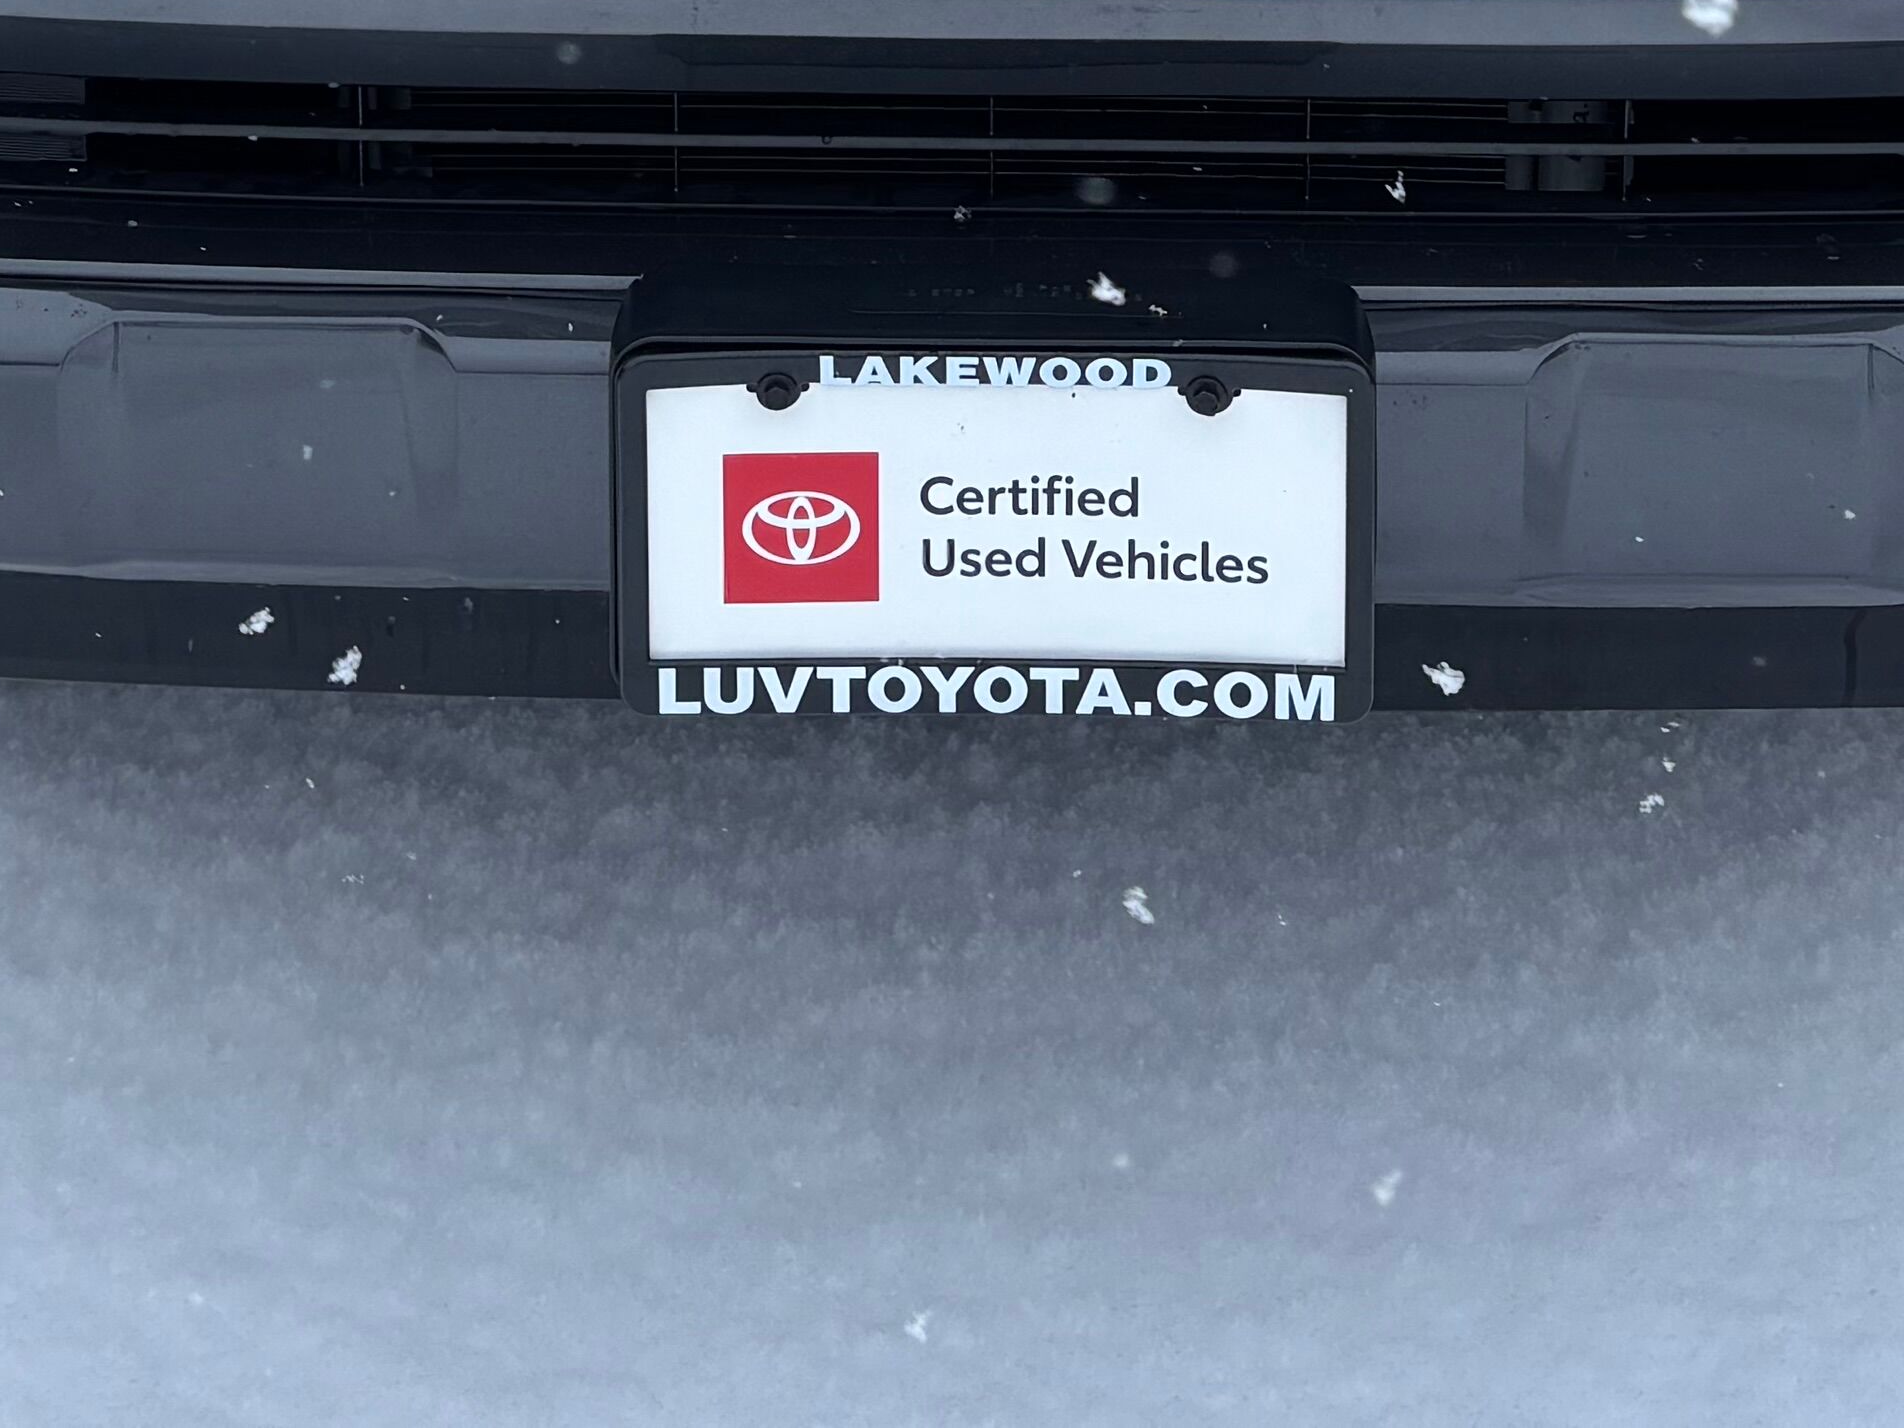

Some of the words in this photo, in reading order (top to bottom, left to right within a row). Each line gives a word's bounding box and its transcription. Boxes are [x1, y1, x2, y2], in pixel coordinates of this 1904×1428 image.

[819, 355, 1173, 389] LAKEWOOD
[919, 475, 1140, 519] Certified
[921, 537, 1047, 578] Used
[1061, 538, 1270, 585] Vehicles
[657, 665, 1337, 723] LUVTOYOTA.COM
